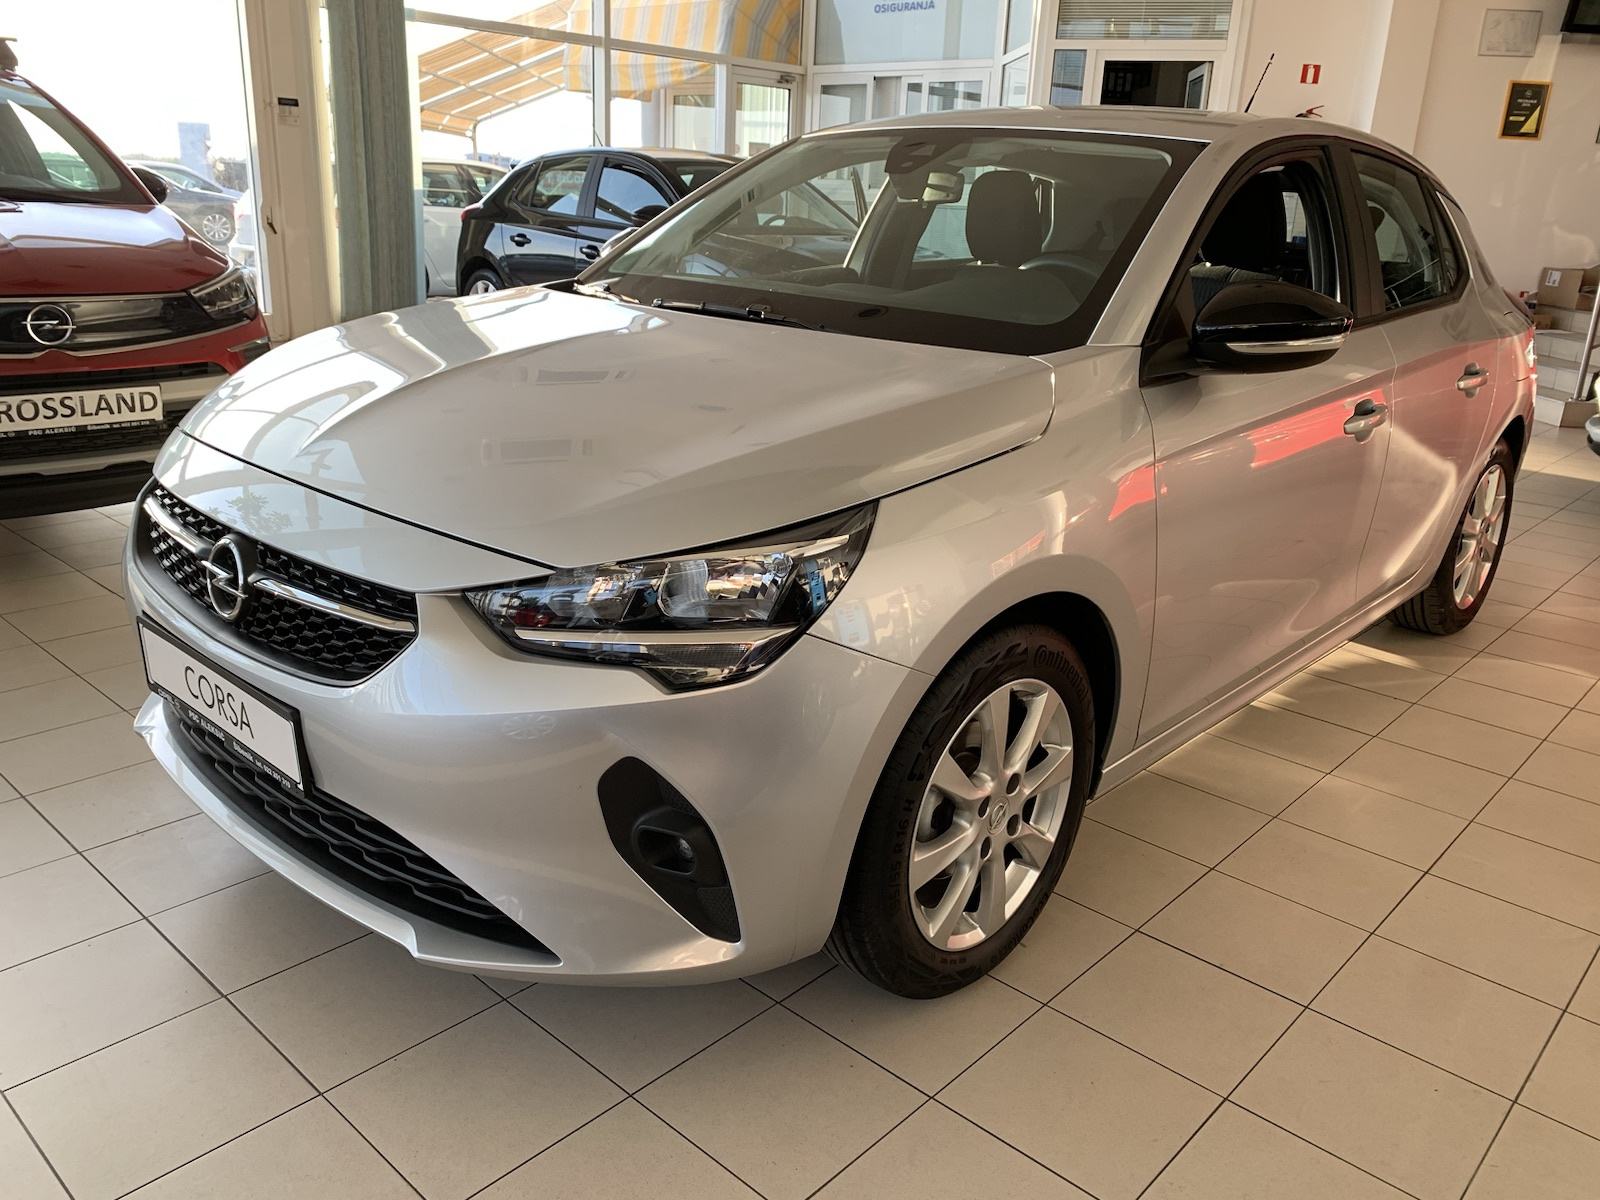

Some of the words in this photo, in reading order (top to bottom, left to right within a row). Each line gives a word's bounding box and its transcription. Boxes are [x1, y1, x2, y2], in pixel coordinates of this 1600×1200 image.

[874, 0, 935, 14] OSIGURANJA
[0, 391, 158, 423] ROSSLAND
[1032, 644, 1089, 706] Continental
[184, 665, 254, 739] CORSA
